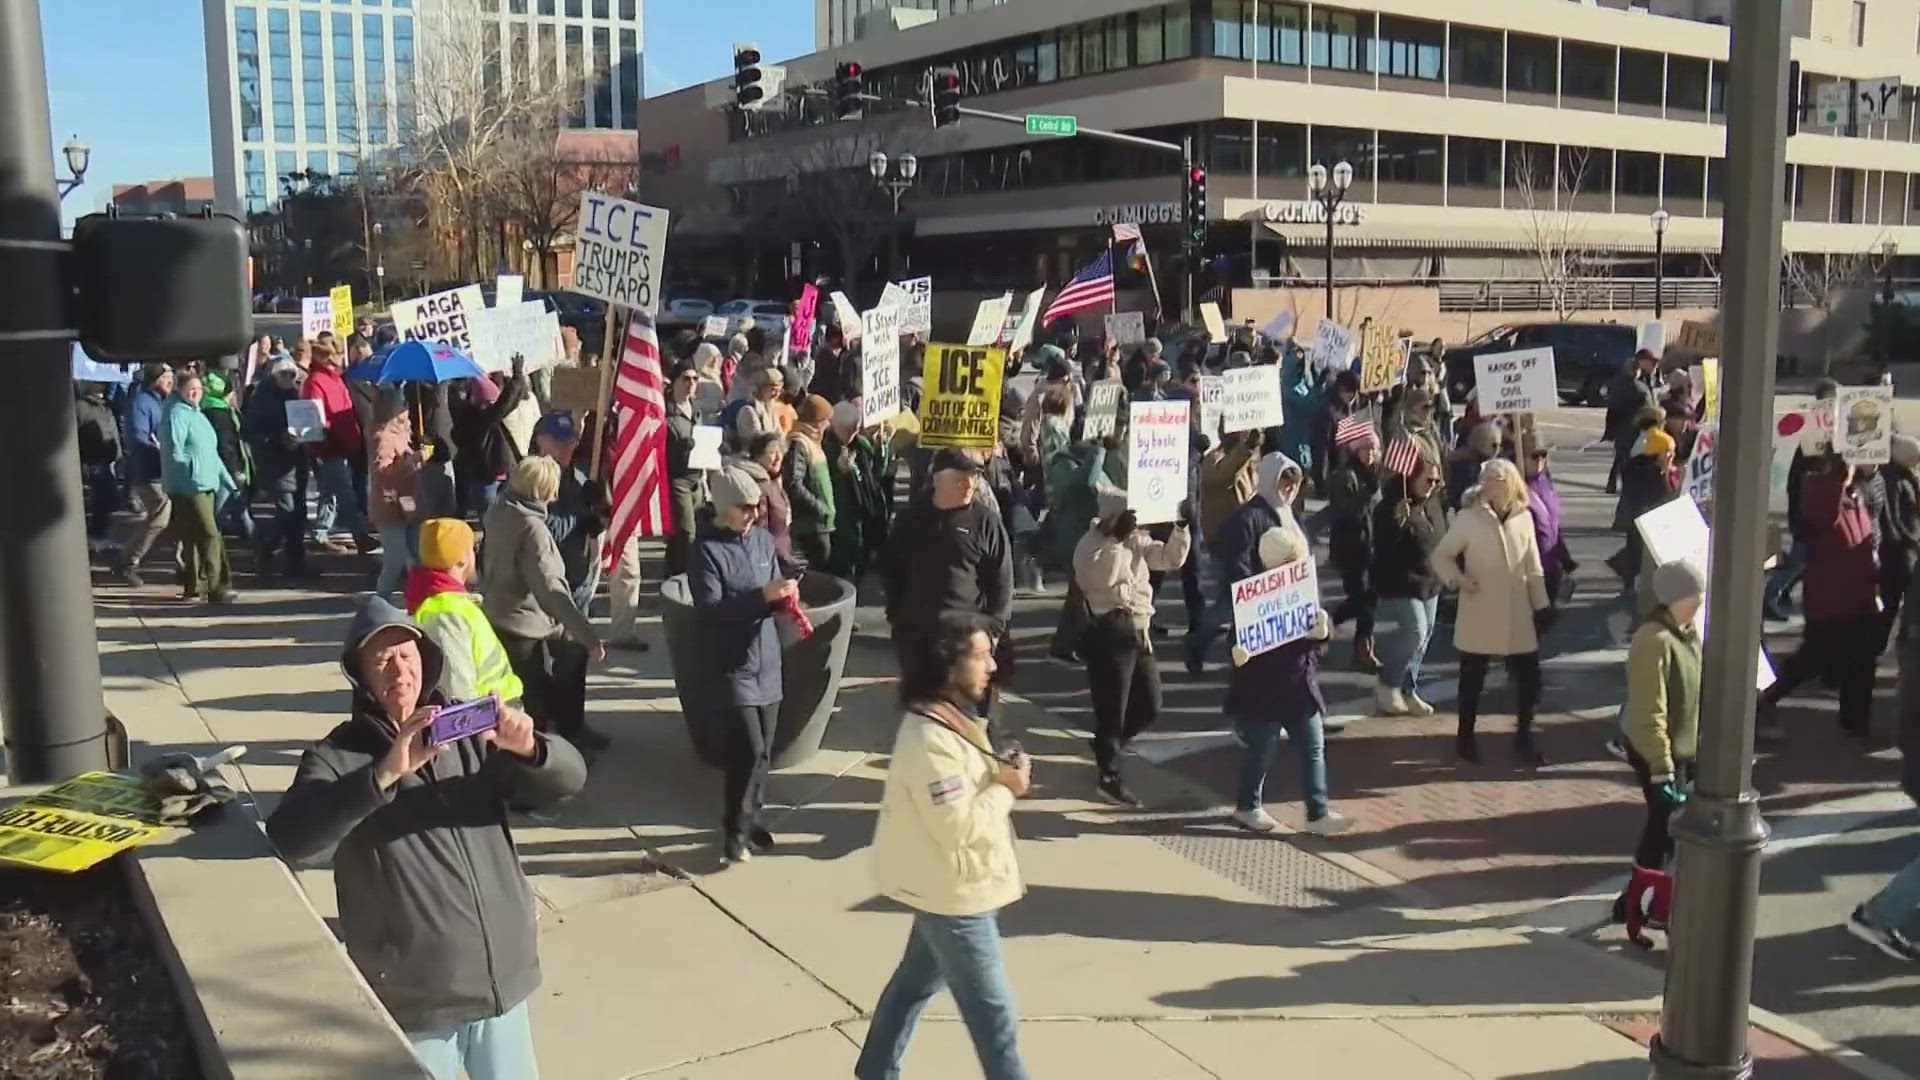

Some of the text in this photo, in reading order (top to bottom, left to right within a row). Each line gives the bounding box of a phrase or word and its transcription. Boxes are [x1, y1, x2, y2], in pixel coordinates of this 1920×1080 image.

[585, 199, 652, 249] ICE
[579, 238, 650, 282] TRUMP'S
[575, 263, 651, 307] GESTAPO
[416, 293, 463, 321] MAGA
[913, 293, 929, 304] UT
[875, 308, 898, 330] Stand
[939, 348, 987, 396] ICE
[1364, 364, 1390, 389] USA
[1487, 357, 1537, 373] HANDS OFF
[871, 367, 889, 391] ICE
[865, 397, 876, 418] GO
[929, 399, 990, 418] OUT OF OUR
[1090, 384, 1119, 409] FIGHT
[922, 416, 995, 436] COMMUNITIES
[1132, 406, 1188, 425] radicalized
[1137, 430, 1177, 453] by basic
[1137, 452, 1181, 474] decency
[1234, 562, 1309, 605] ABOLISH ICE
[1257, 590, 1300, 616] GIVE US
